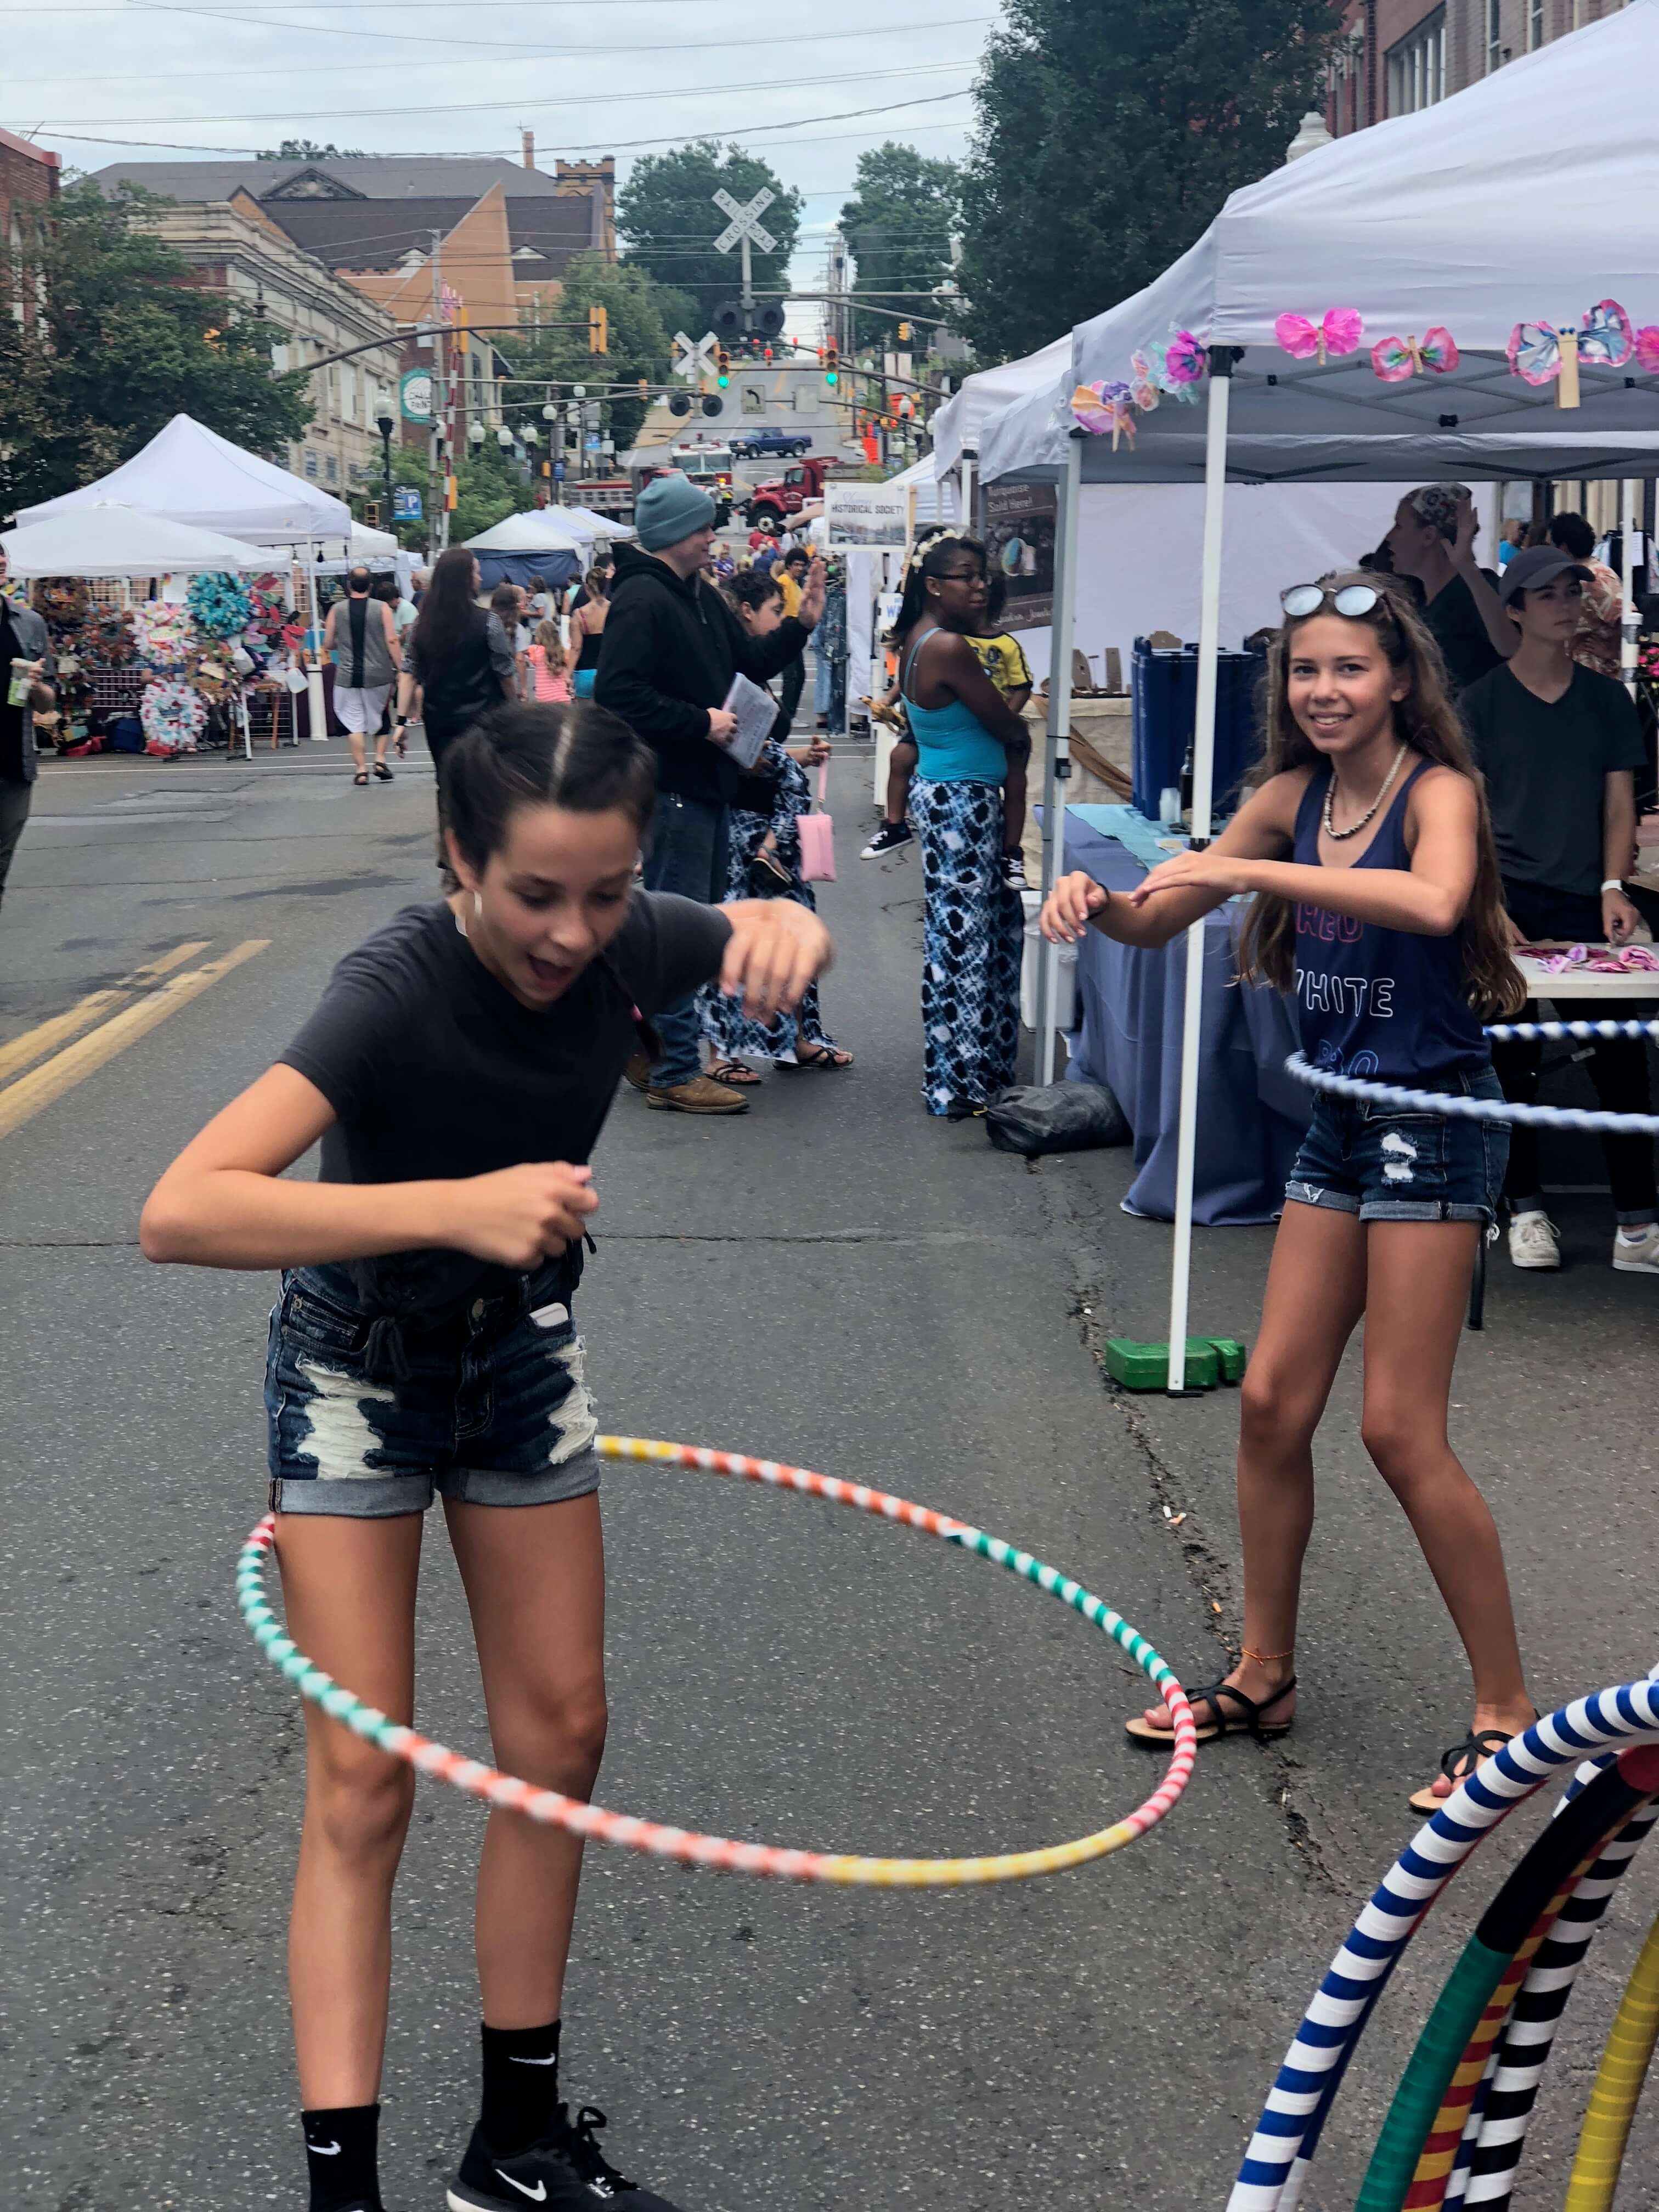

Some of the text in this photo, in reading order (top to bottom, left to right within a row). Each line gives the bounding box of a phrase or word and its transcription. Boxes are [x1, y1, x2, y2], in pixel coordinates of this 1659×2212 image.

[719, 189, 771, 249] CROSSING
[831, 504, 905, 515] HISTORICAL SOCIETY
[1295, 968, 1395, 1018] HITE
